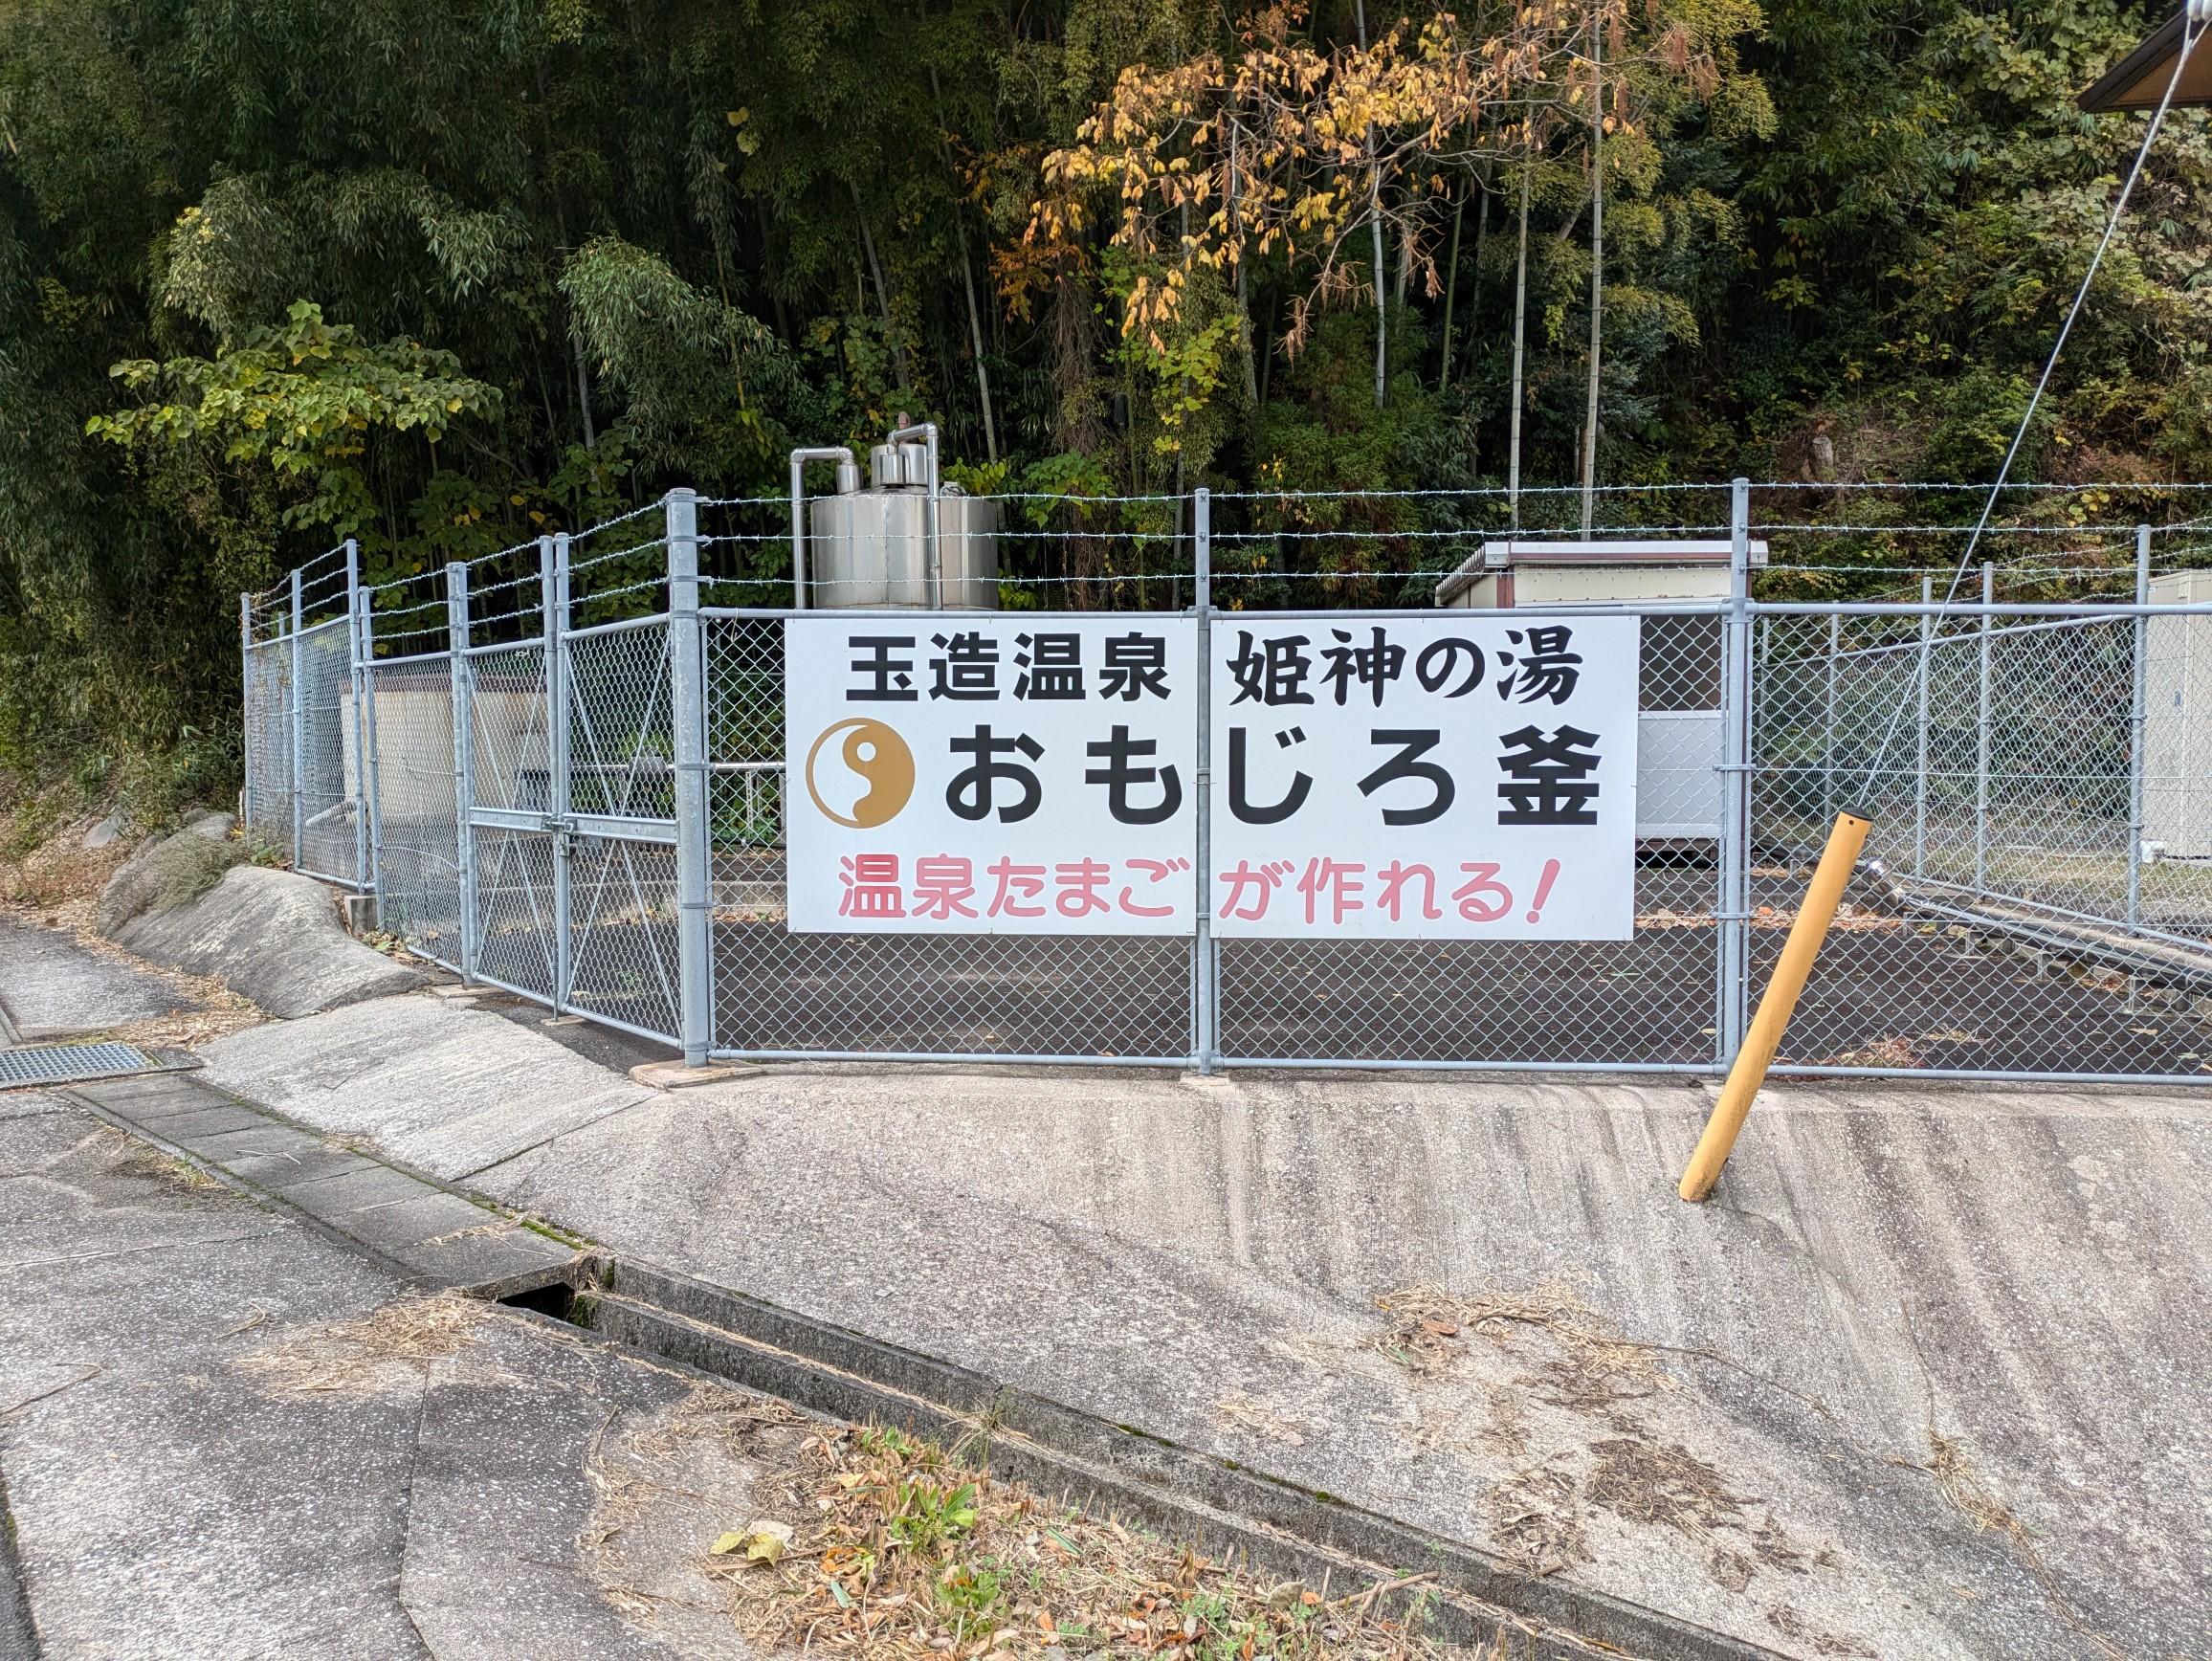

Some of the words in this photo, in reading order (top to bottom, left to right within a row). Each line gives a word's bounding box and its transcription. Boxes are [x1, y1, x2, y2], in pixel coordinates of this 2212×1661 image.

[847, 631, 1172, 702] 玉造温泉
[1227, 625, 1583, 708] 姫神の湯
[946, 724, 1602, 826] おもじろ釜
